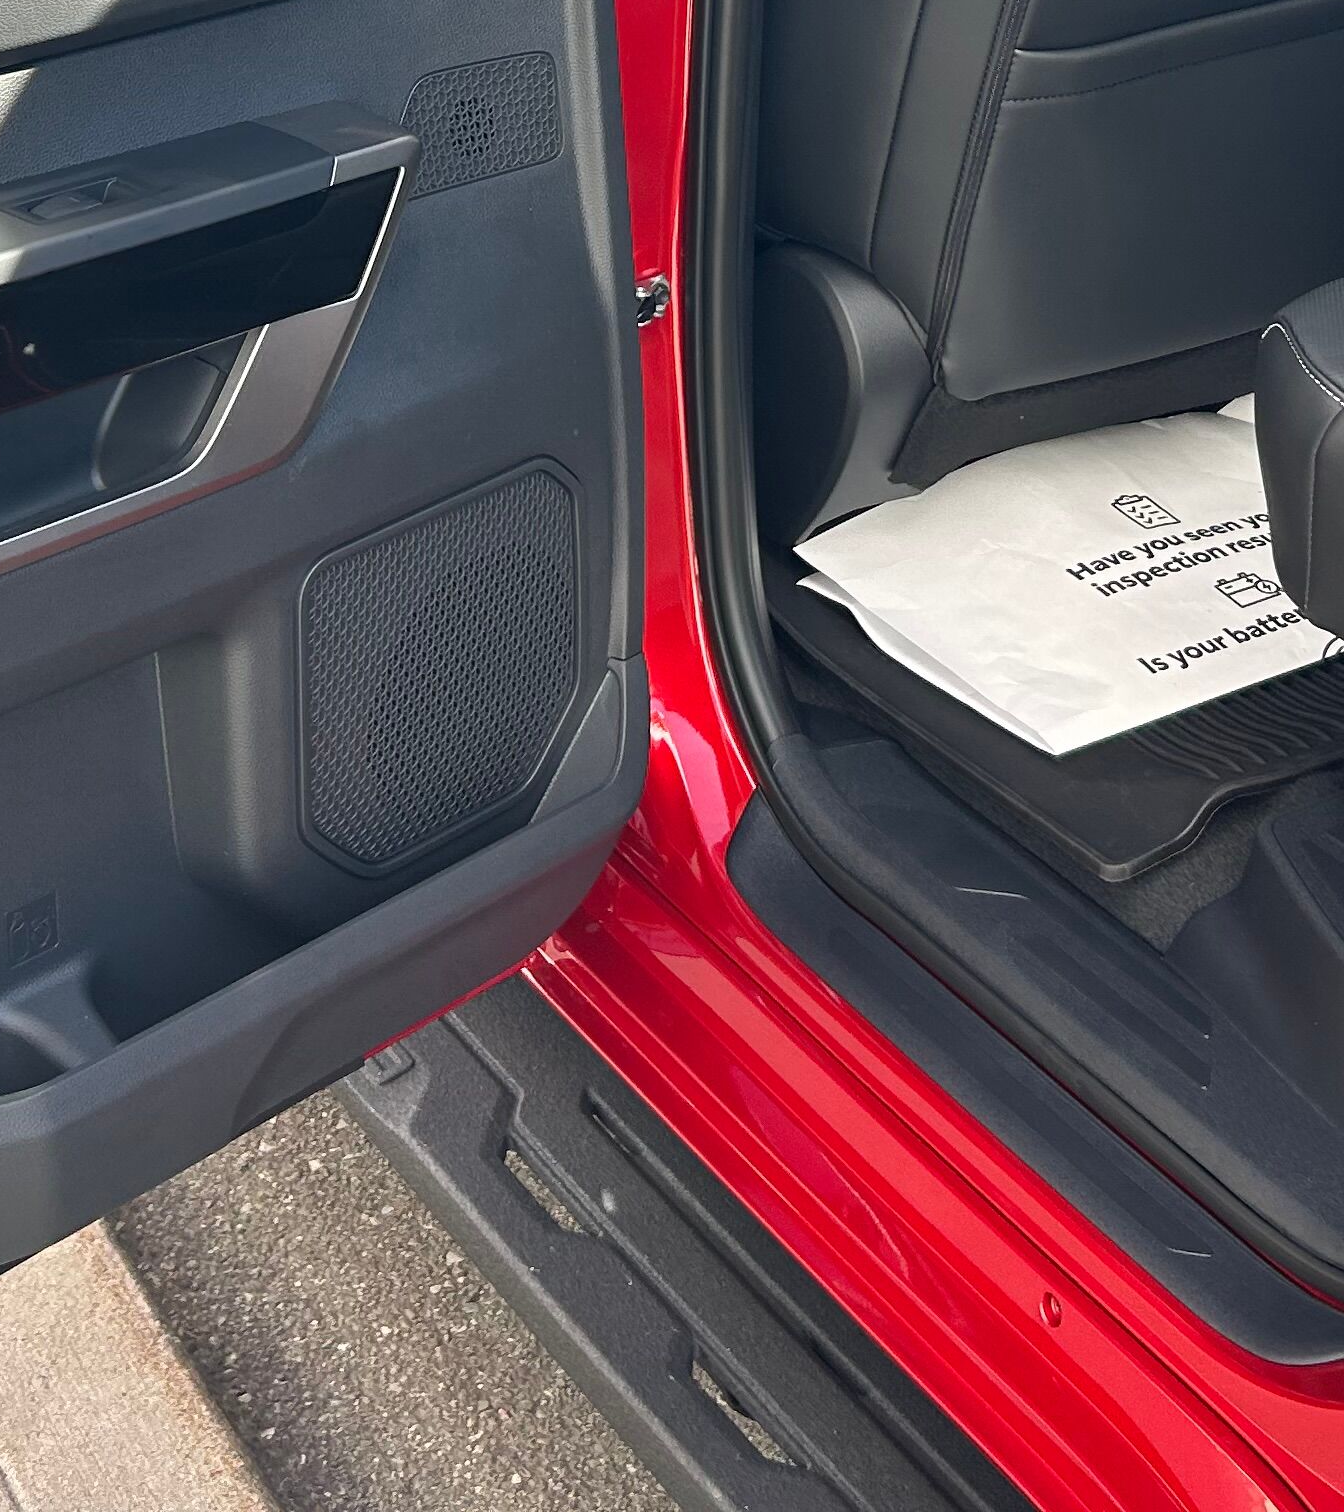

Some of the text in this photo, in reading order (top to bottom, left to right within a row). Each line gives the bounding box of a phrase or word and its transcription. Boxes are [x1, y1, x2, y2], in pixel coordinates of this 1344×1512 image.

[1066, 550, 1136, 580] Have
[1133, 534, 1185, 559] you
[1183, 521, 1243, 541] seen
[1091, 545, 1227, 597] inspection
[1137, 656, 1170, 674] Is
[1166, 635, 1229, 669] your
